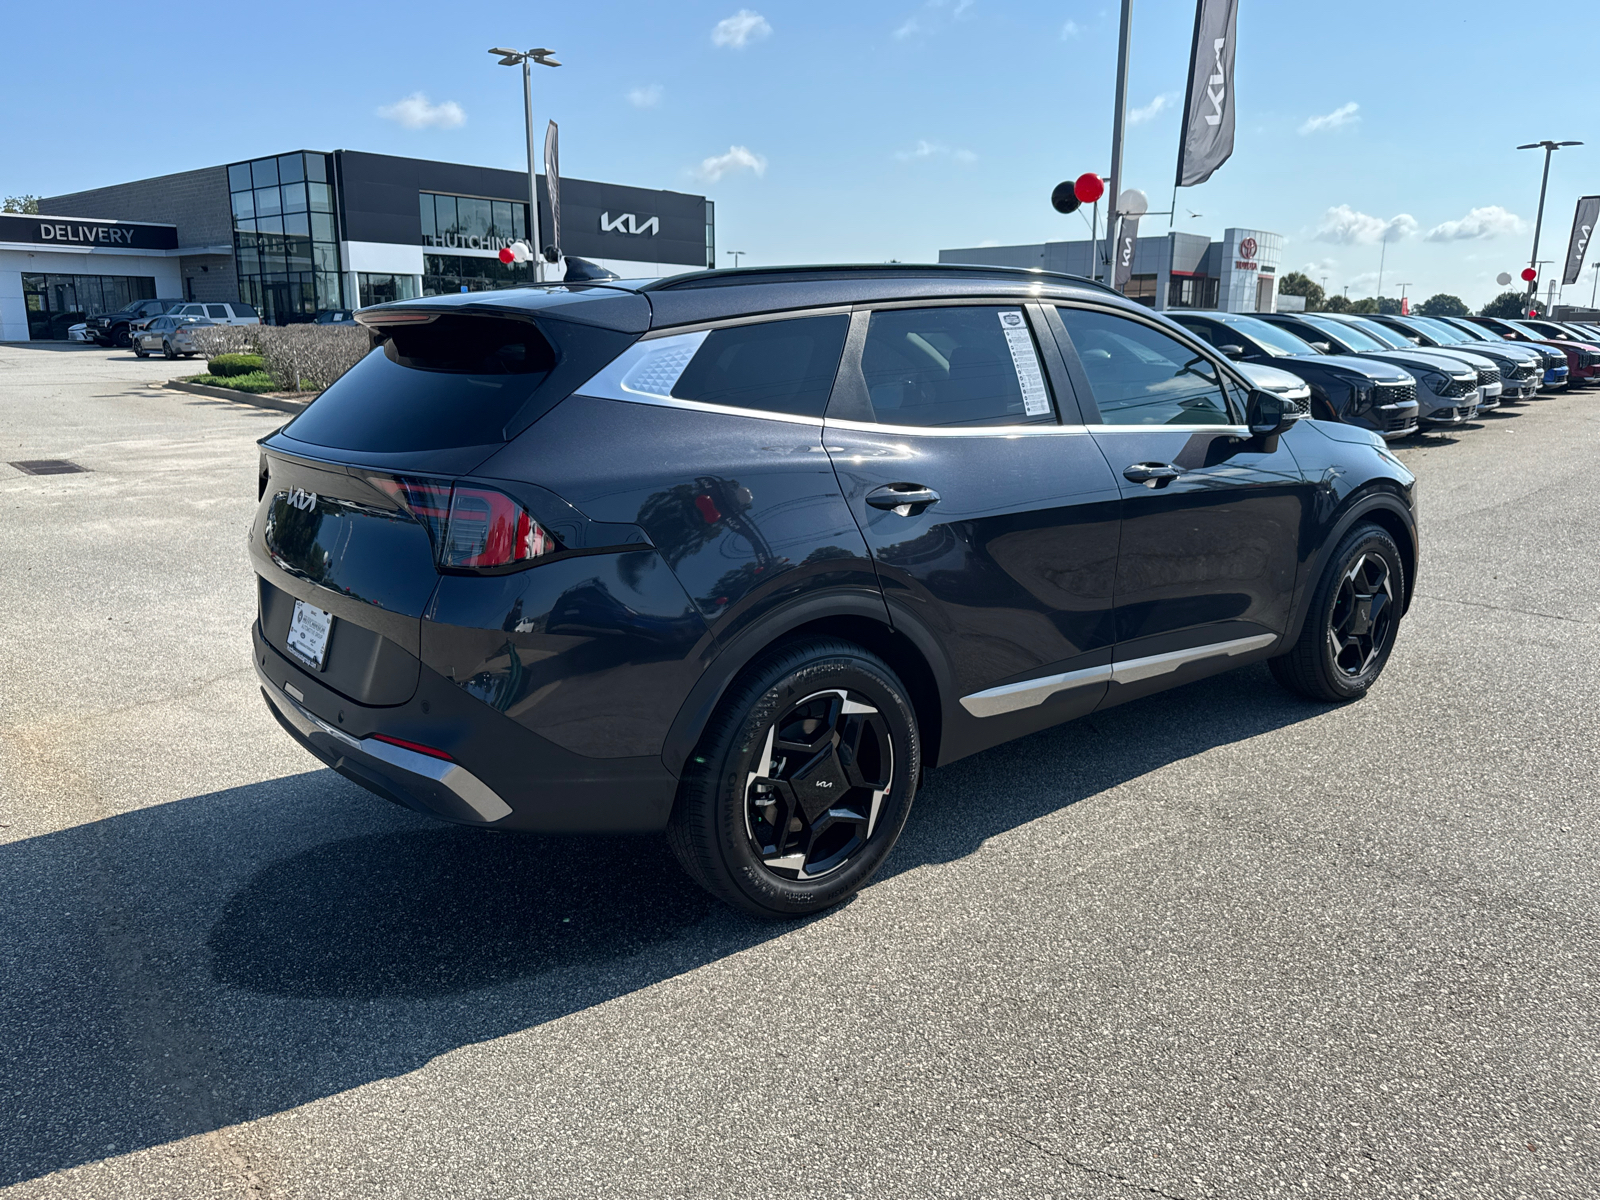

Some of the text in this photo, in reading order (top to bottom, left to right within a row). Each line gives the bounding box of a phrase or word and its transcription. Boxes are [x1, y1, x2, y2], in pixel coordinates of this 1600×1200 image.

[1205, 37, 1225, 125] KIA
[40, 224, 134, 243] DELIVERY
[601, 211, 659, 236] KIA
[433, 232, 534, 252] HUTCHINSN
[1122, 238, 1132, 267] KIA
[287, 485, 316, 513] KIA
[724, 772, 737, 850] KUMHO
